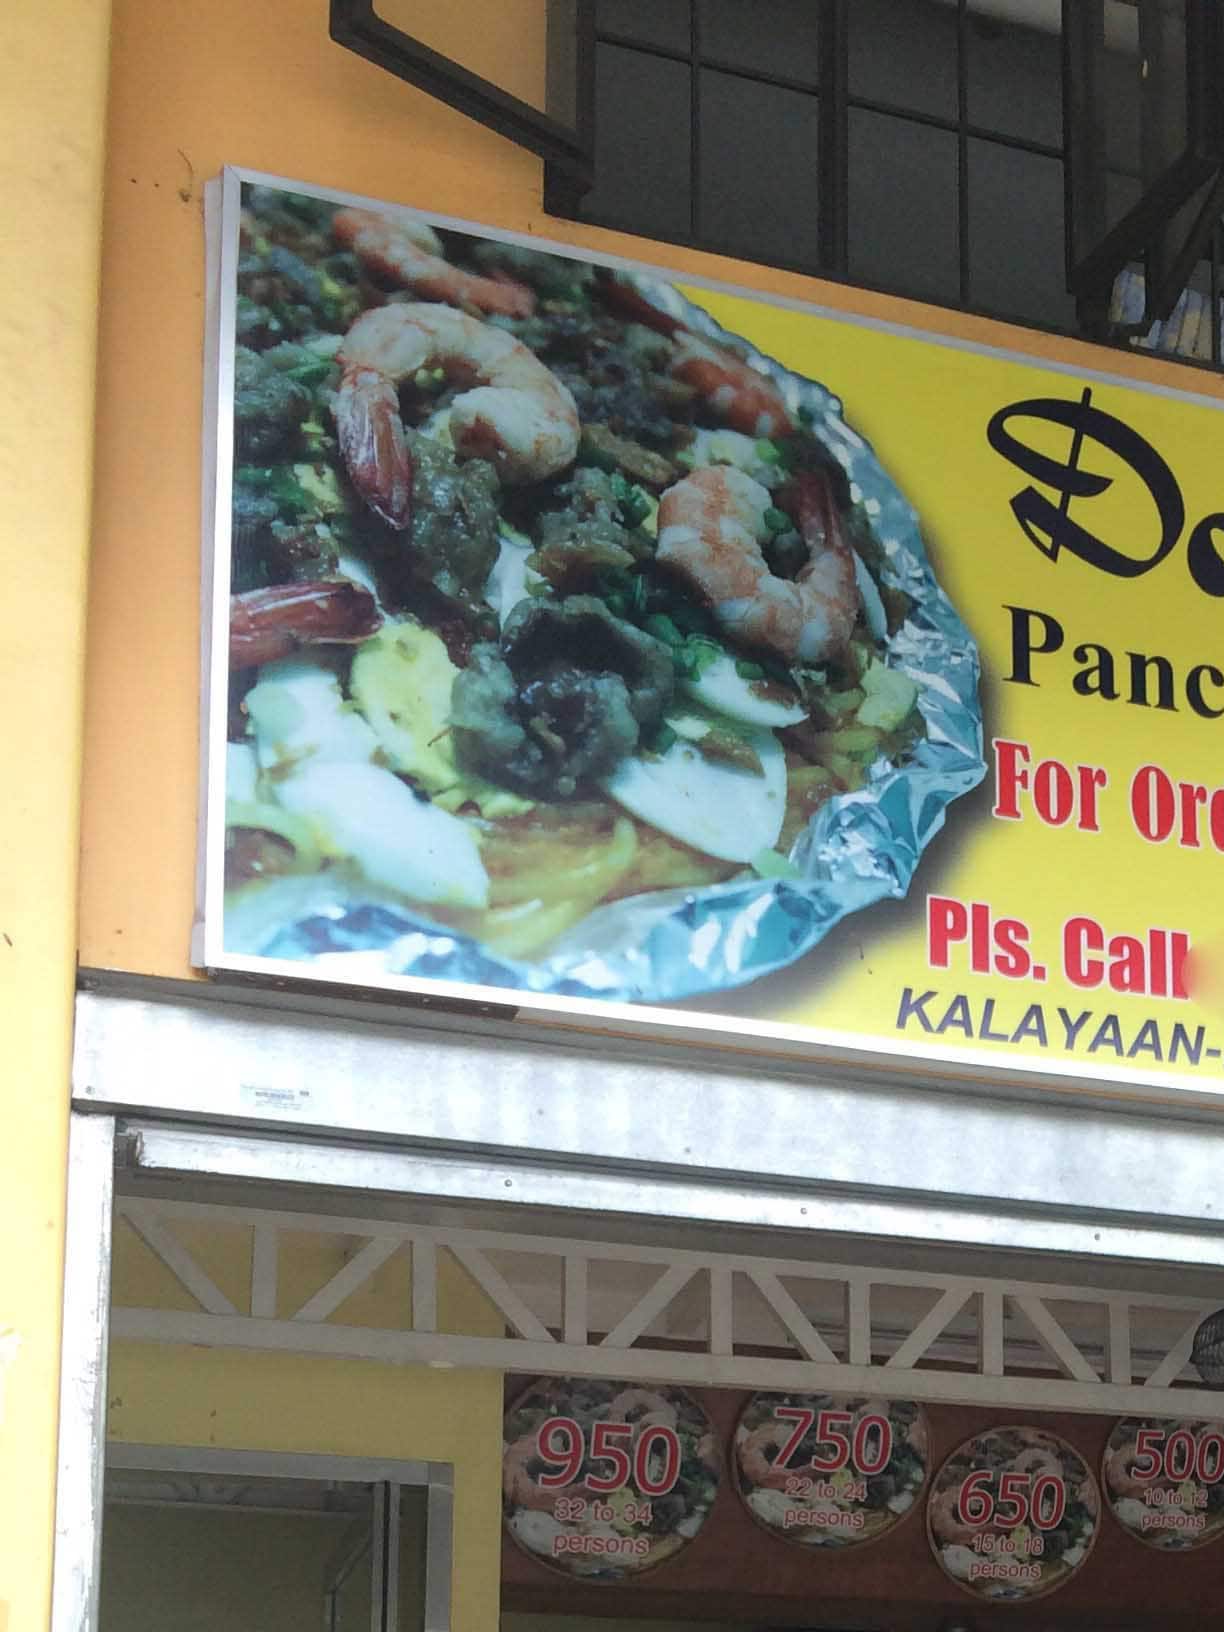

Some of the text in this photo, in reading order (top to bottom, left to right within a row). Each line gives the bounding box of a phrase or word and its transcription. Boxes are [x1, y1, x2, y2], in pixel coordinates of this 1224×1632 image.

[993, 739, 1107, 832] For
[928, 895, 1046, 982] Pls.
[1063, 916, 1190, 1000] Call
[774, 1407, 893, 1475] 750
[536, 1417, 682, 1496] 950
[785, 1476, 867, 1502] 22 to 24
[958, 1470, 1066, 1529] 650
[554, 1496, 654, 1525] 32 to 34
[783, 1506, 865, 1529] persons
[1141, 1512, 1208, 1532] persons
[553, 1533, 650, 1557] persons
[973, 1534, 1045, 1556] 15 to 18
[968, 1561, 1042, 1581] persons
